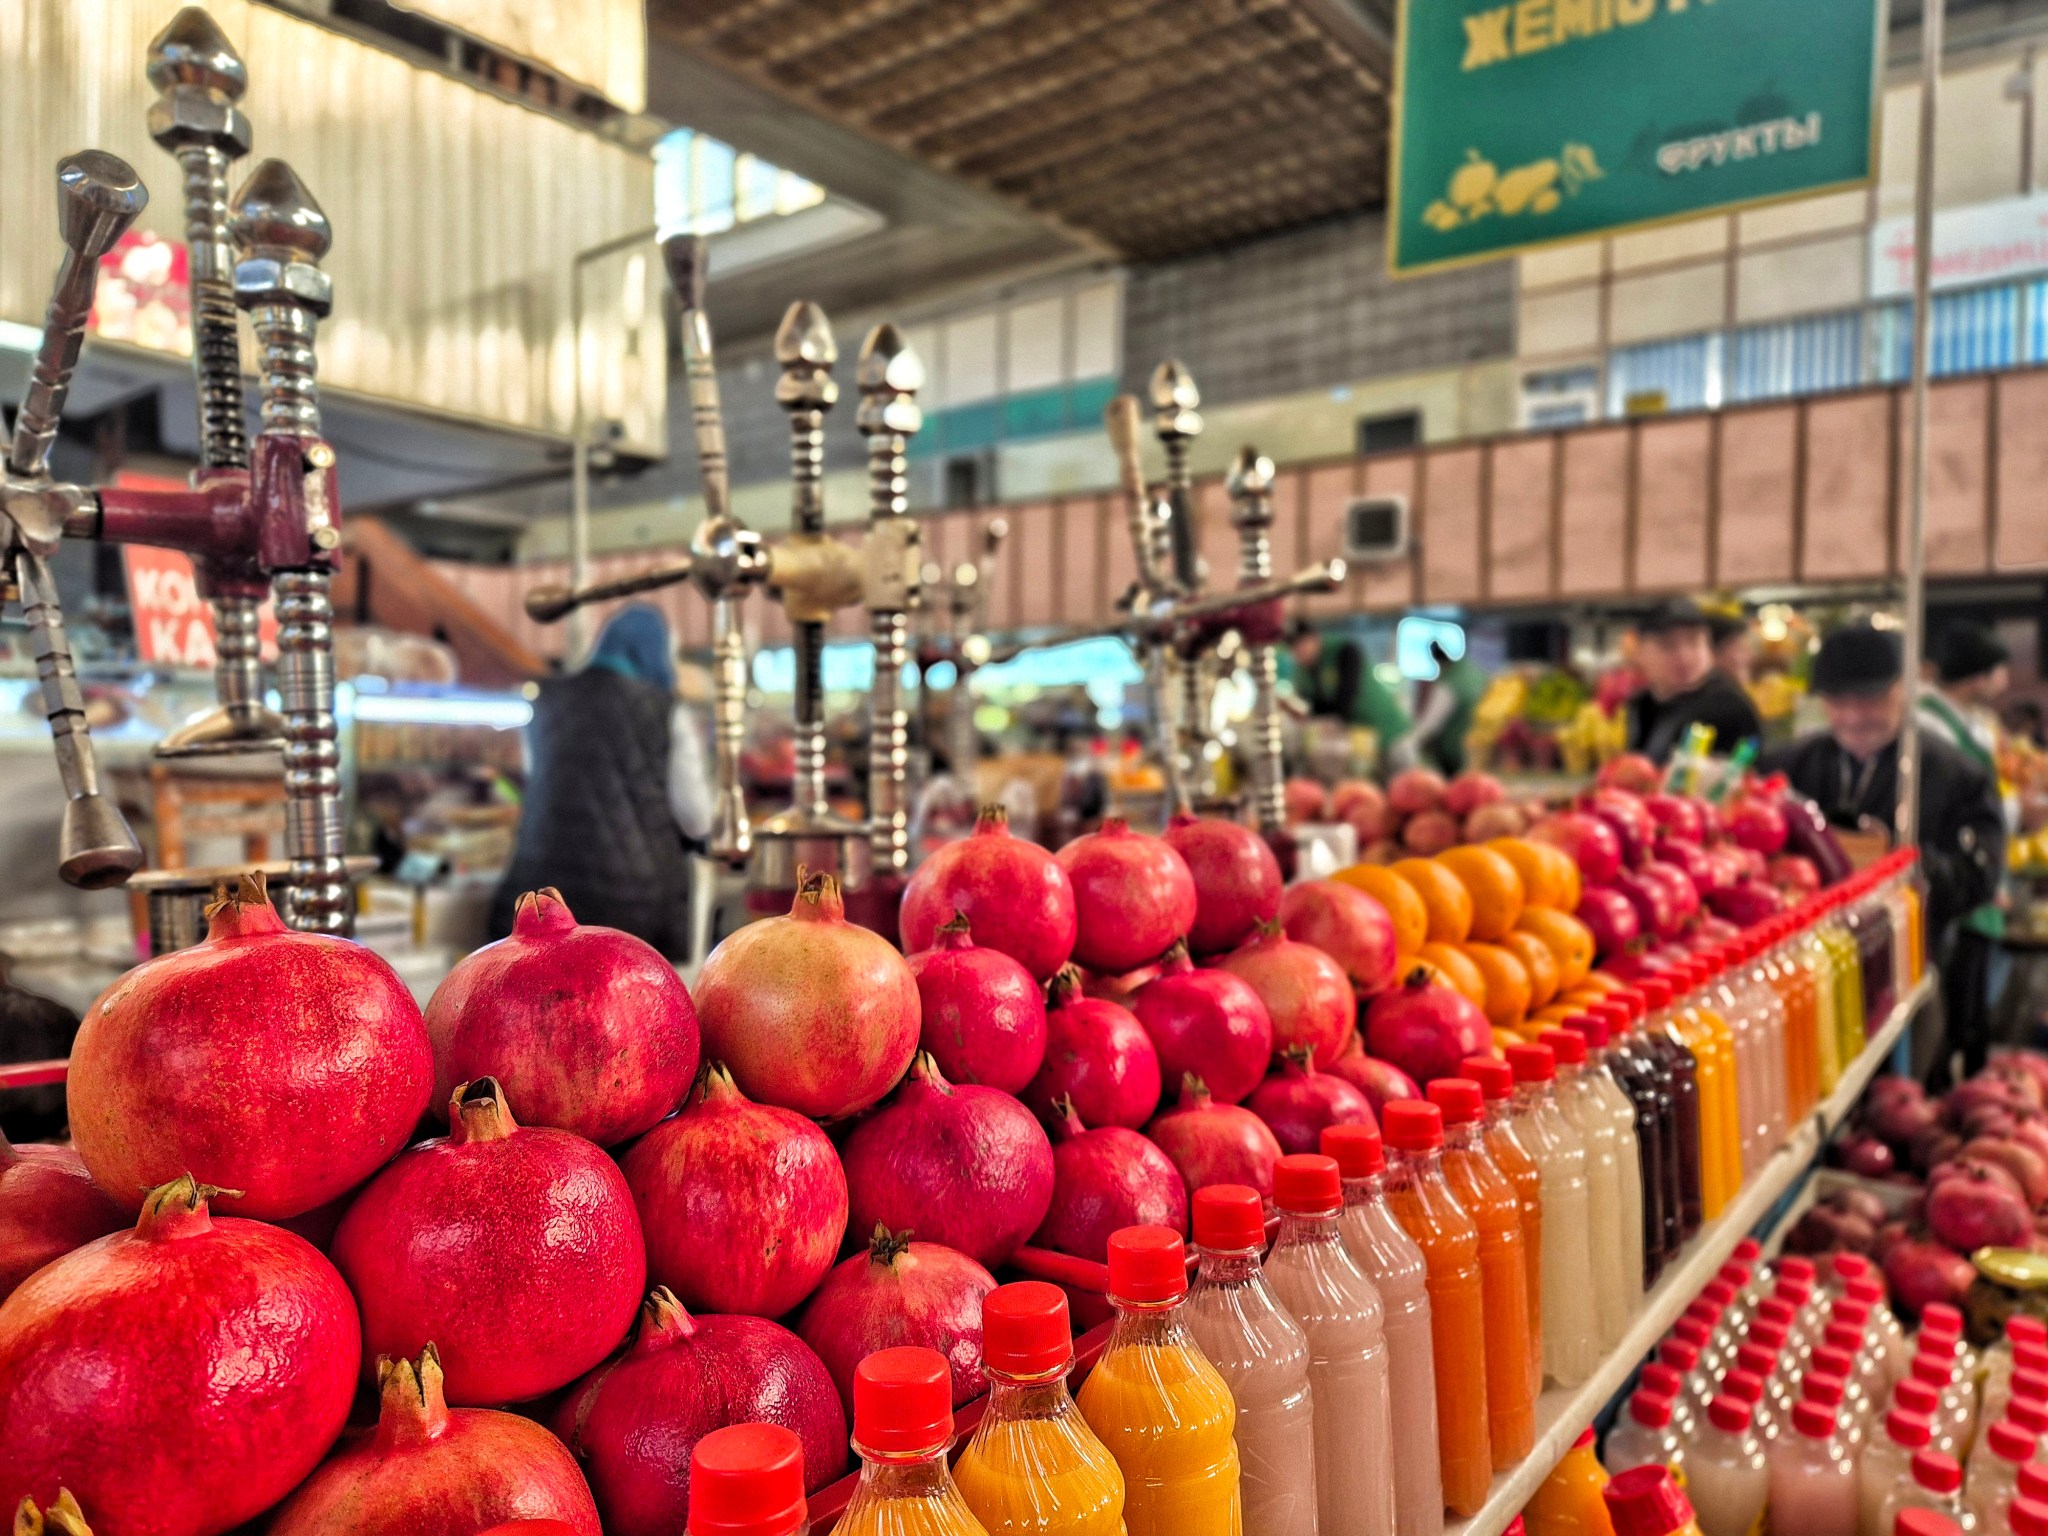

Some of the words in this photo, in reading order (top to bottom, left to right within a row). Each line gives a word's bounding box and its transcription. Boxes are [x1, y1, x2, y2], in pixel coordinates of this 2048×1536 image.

[1460, 0, 1712, 71] ЖЕМІС
[1656, 111, 1822, 174] ФРУКТЫ
[133, 567, 202, 616] КО
